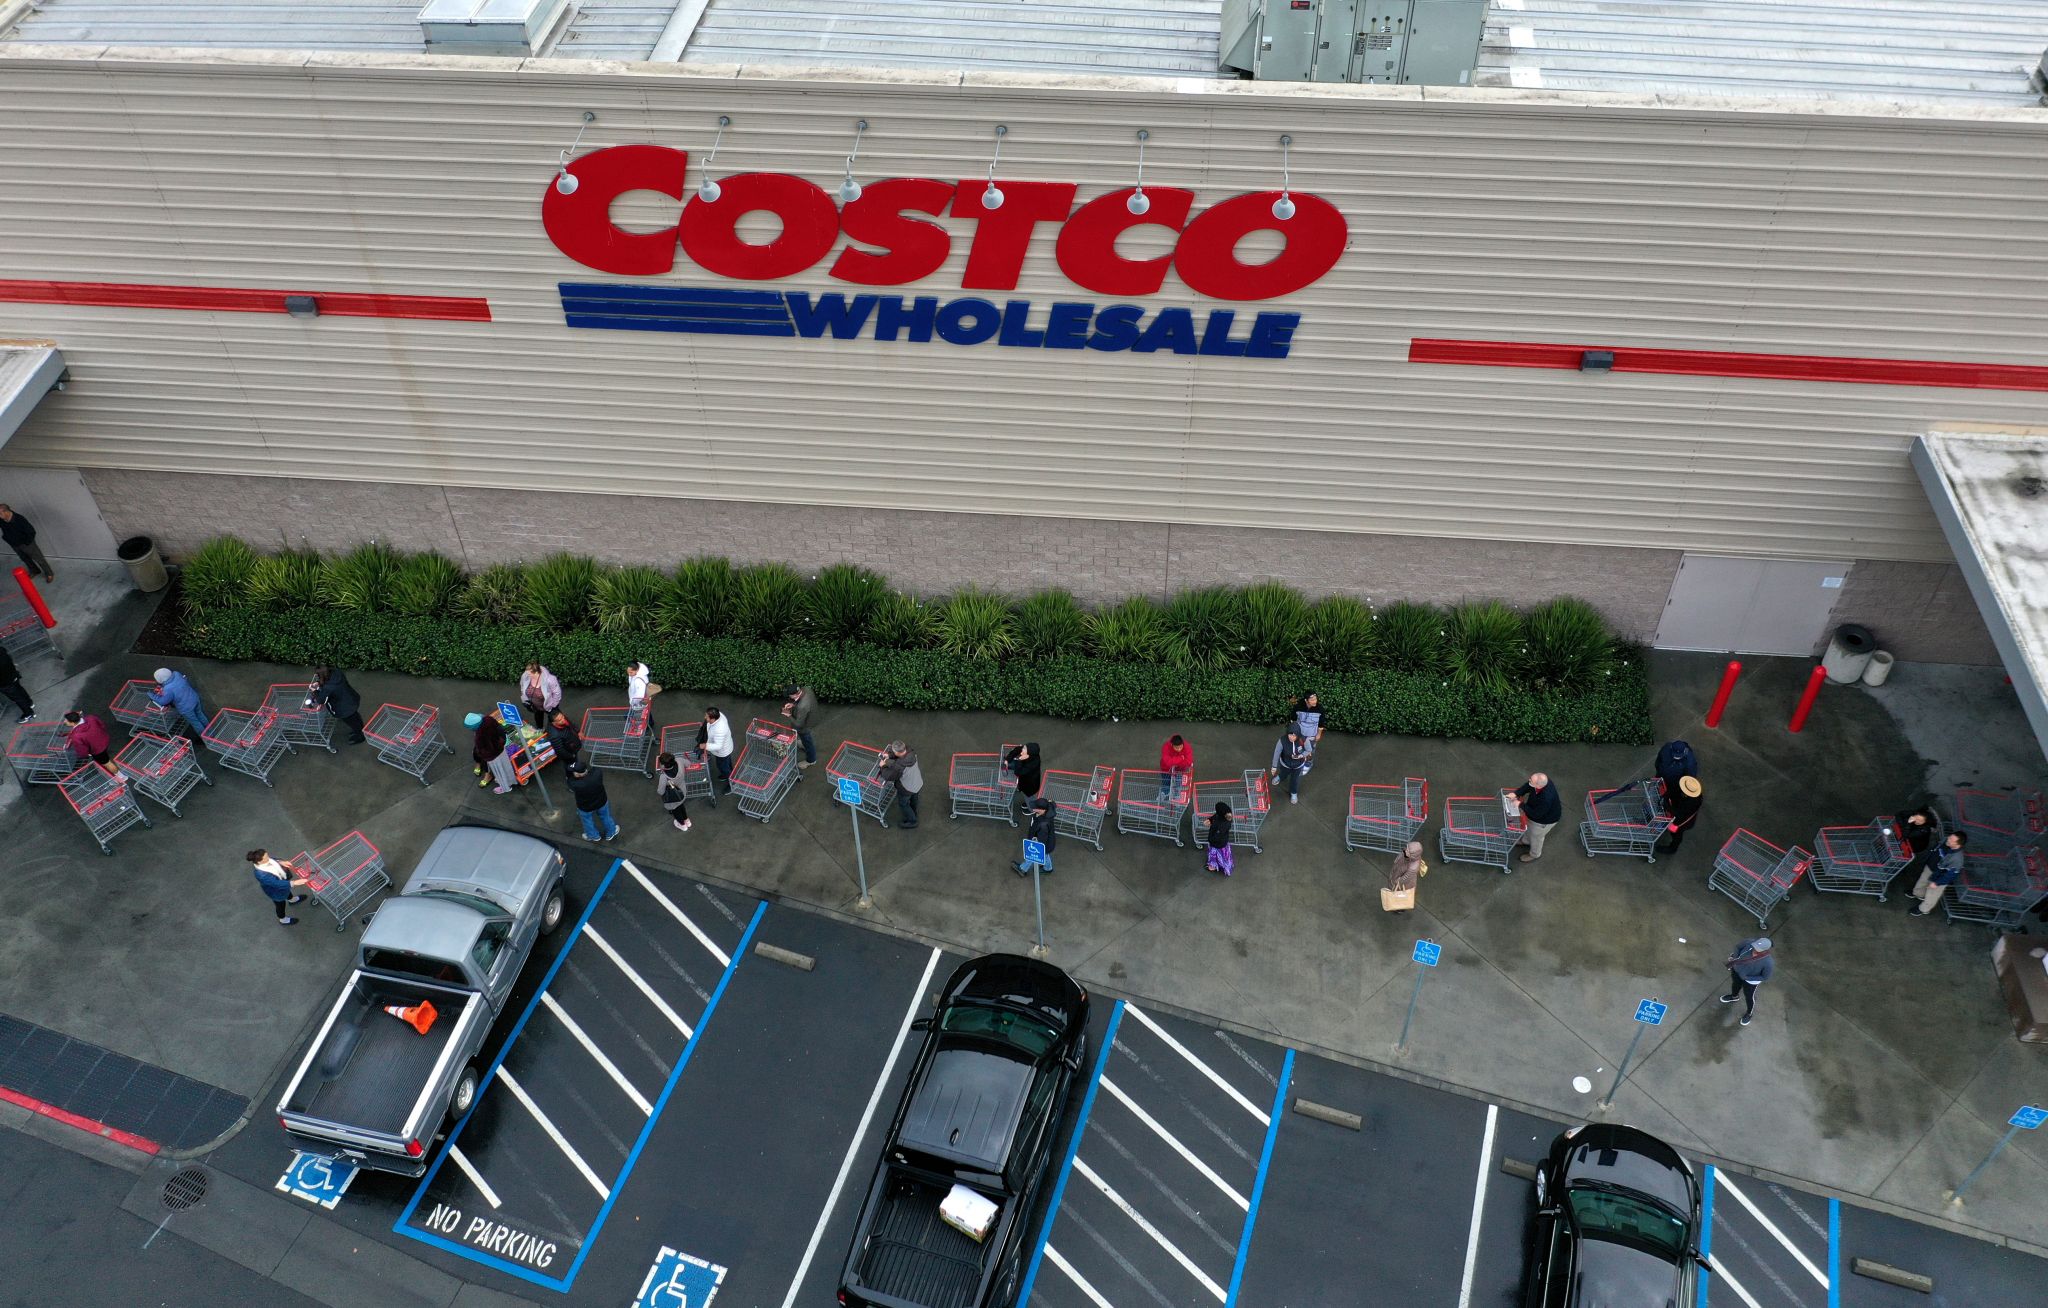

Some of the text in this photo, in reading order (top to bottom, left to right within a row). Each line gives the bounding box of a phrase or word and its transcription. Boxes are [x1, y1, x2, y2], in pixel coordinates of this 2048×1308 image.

[543, 145, 1347, 300] COSTCO
[785, 292, 1300, 358] WHOLESALE
[1637, 1010, 1660, 1020] PARKING
[1640, 1015, 1654, 1023] ONLY
[426, 1203, 557, 1268] NO PARKING
